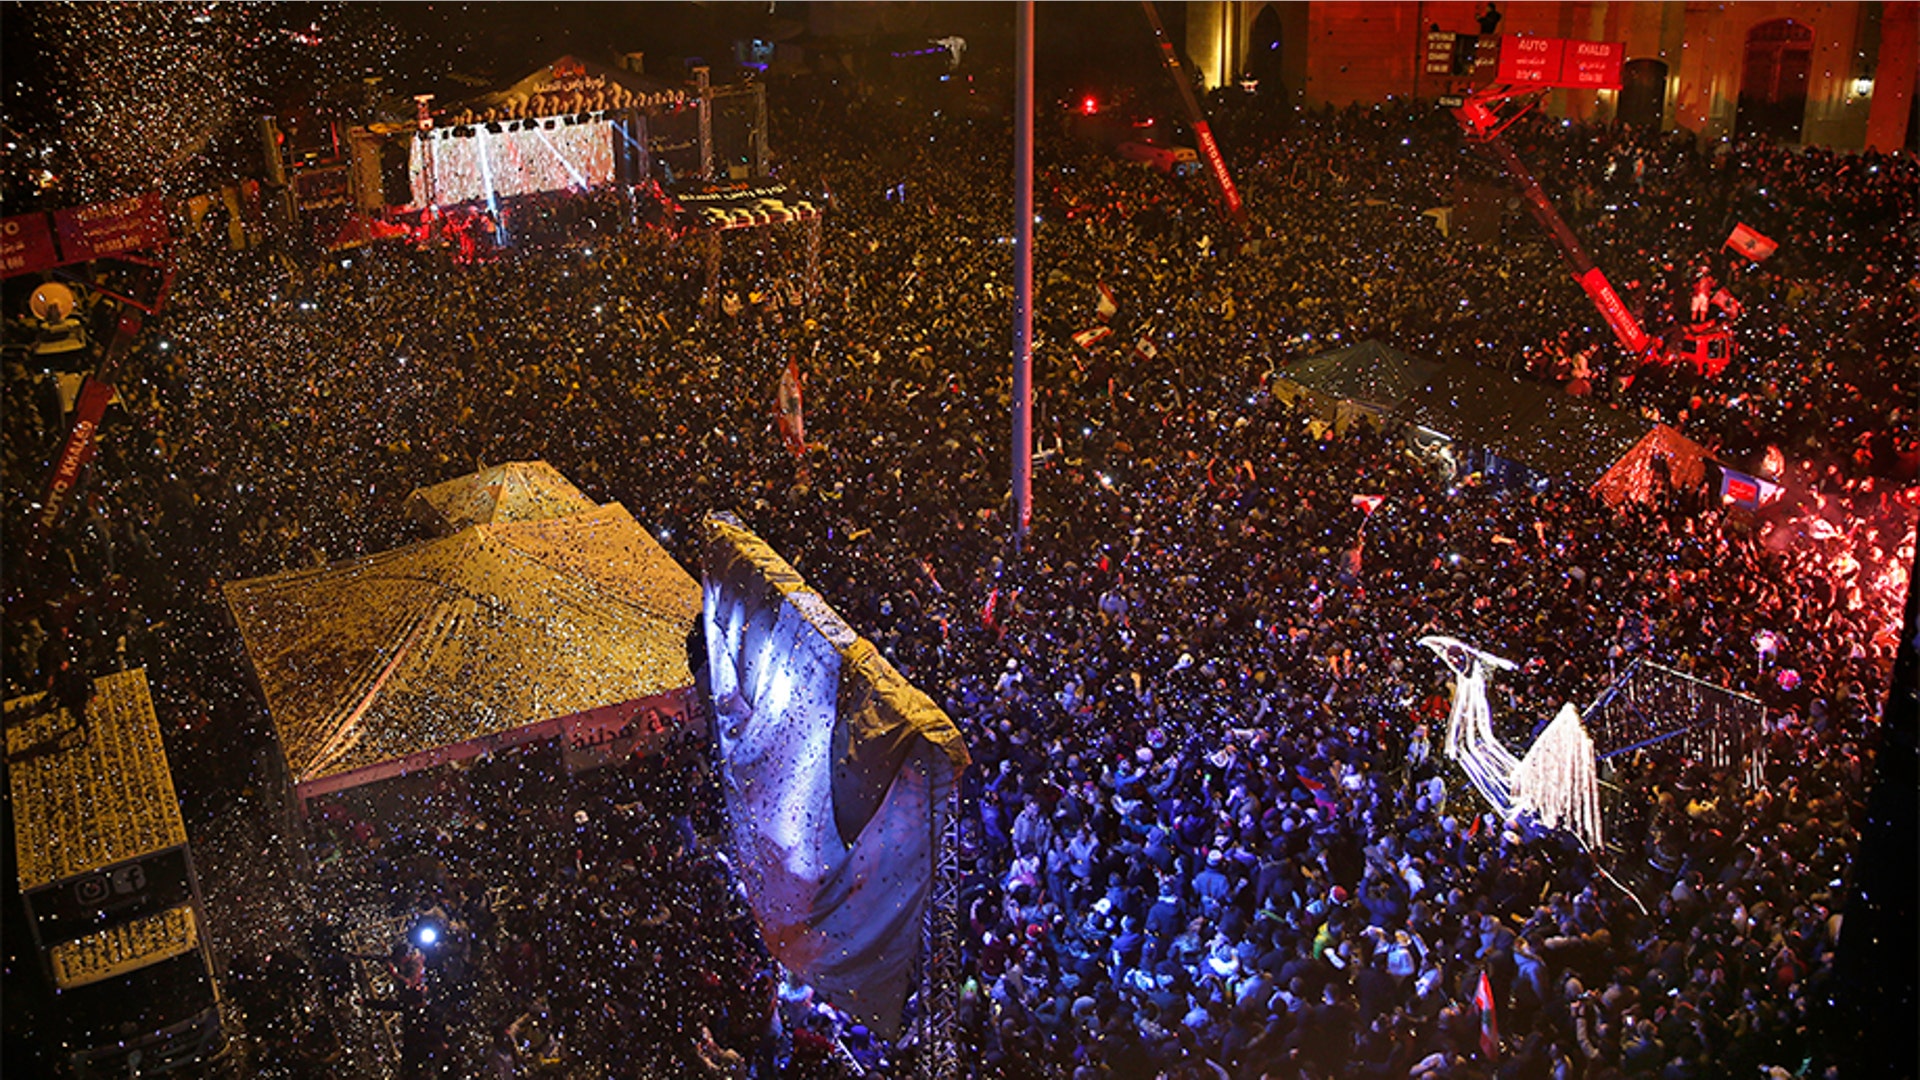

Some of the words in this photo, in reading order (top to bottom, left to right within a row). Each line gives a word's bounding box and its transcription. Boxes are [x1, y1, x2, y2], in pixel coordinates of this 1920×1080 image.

[1518, 40, 1548, 52] AUTO
[1577, 44, 1611, 56] KHALED
[1202, 132, 1218, 159] AUTO
[1213, 158, 1231, 189] KHALED
[41, 479, 69, 528] AUTO
[60, 420, 94, 477] KHALED
